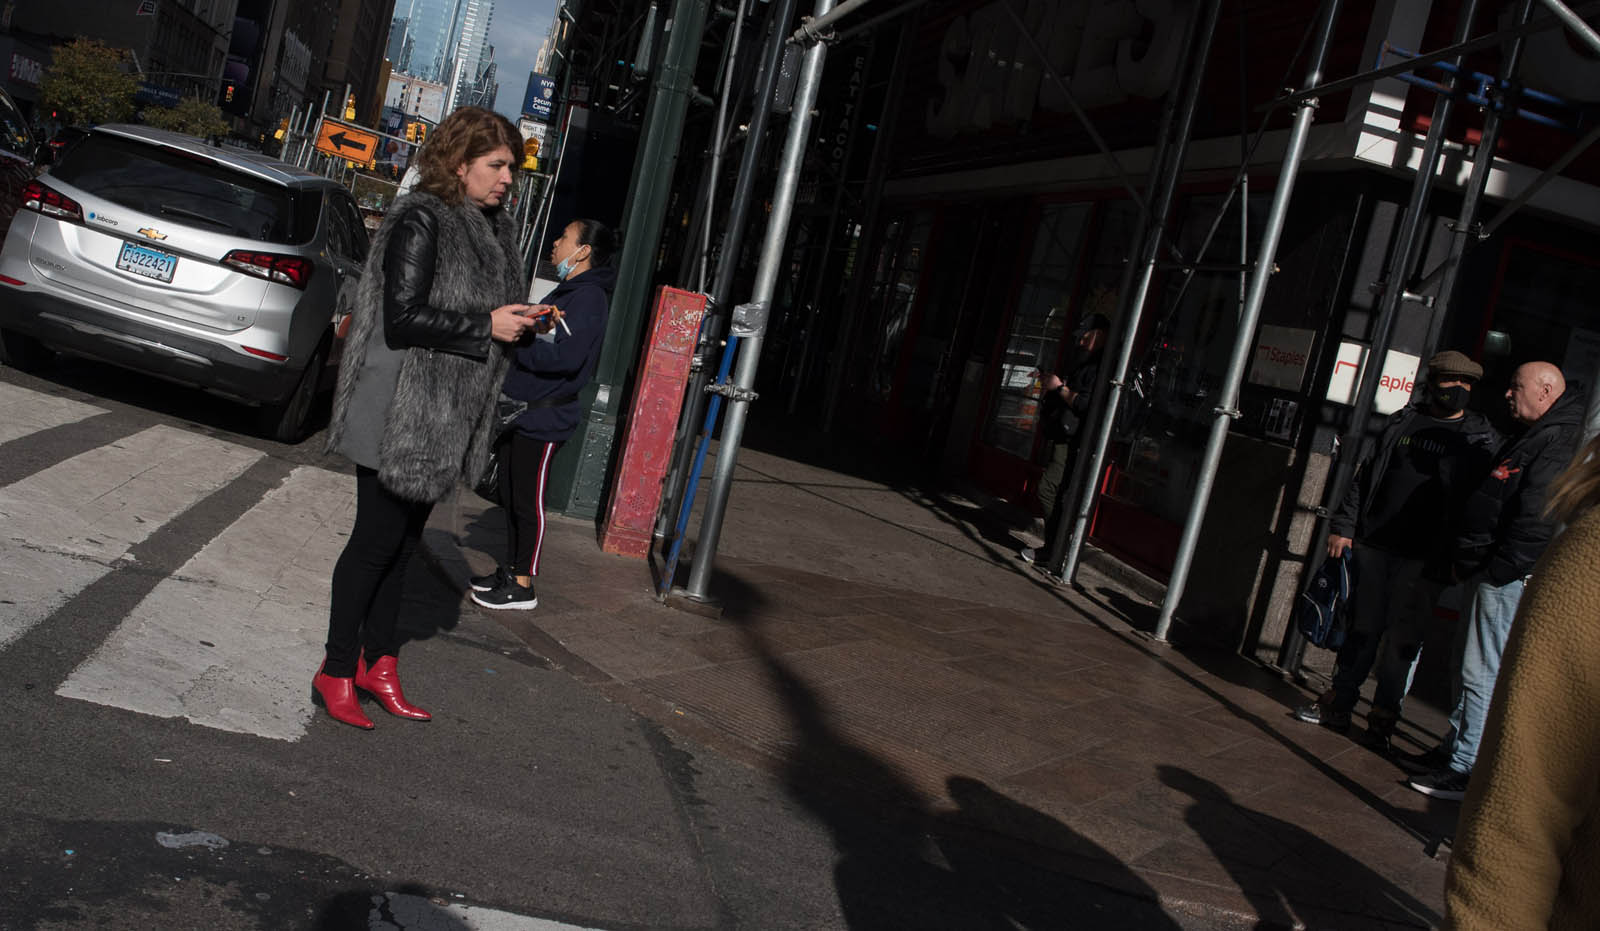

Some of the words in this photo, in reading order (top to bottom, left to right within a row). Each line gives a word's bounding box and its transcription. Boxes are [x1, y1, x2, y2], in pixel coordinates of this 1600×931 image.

[541, 79, 555, 88] NYP
[532, 103, 550, 113] Came
[96, 213, 119, 226] labcorp
[1271, 348, 1306, 366] Staples
[1379, 375, 1415, 394] aple
